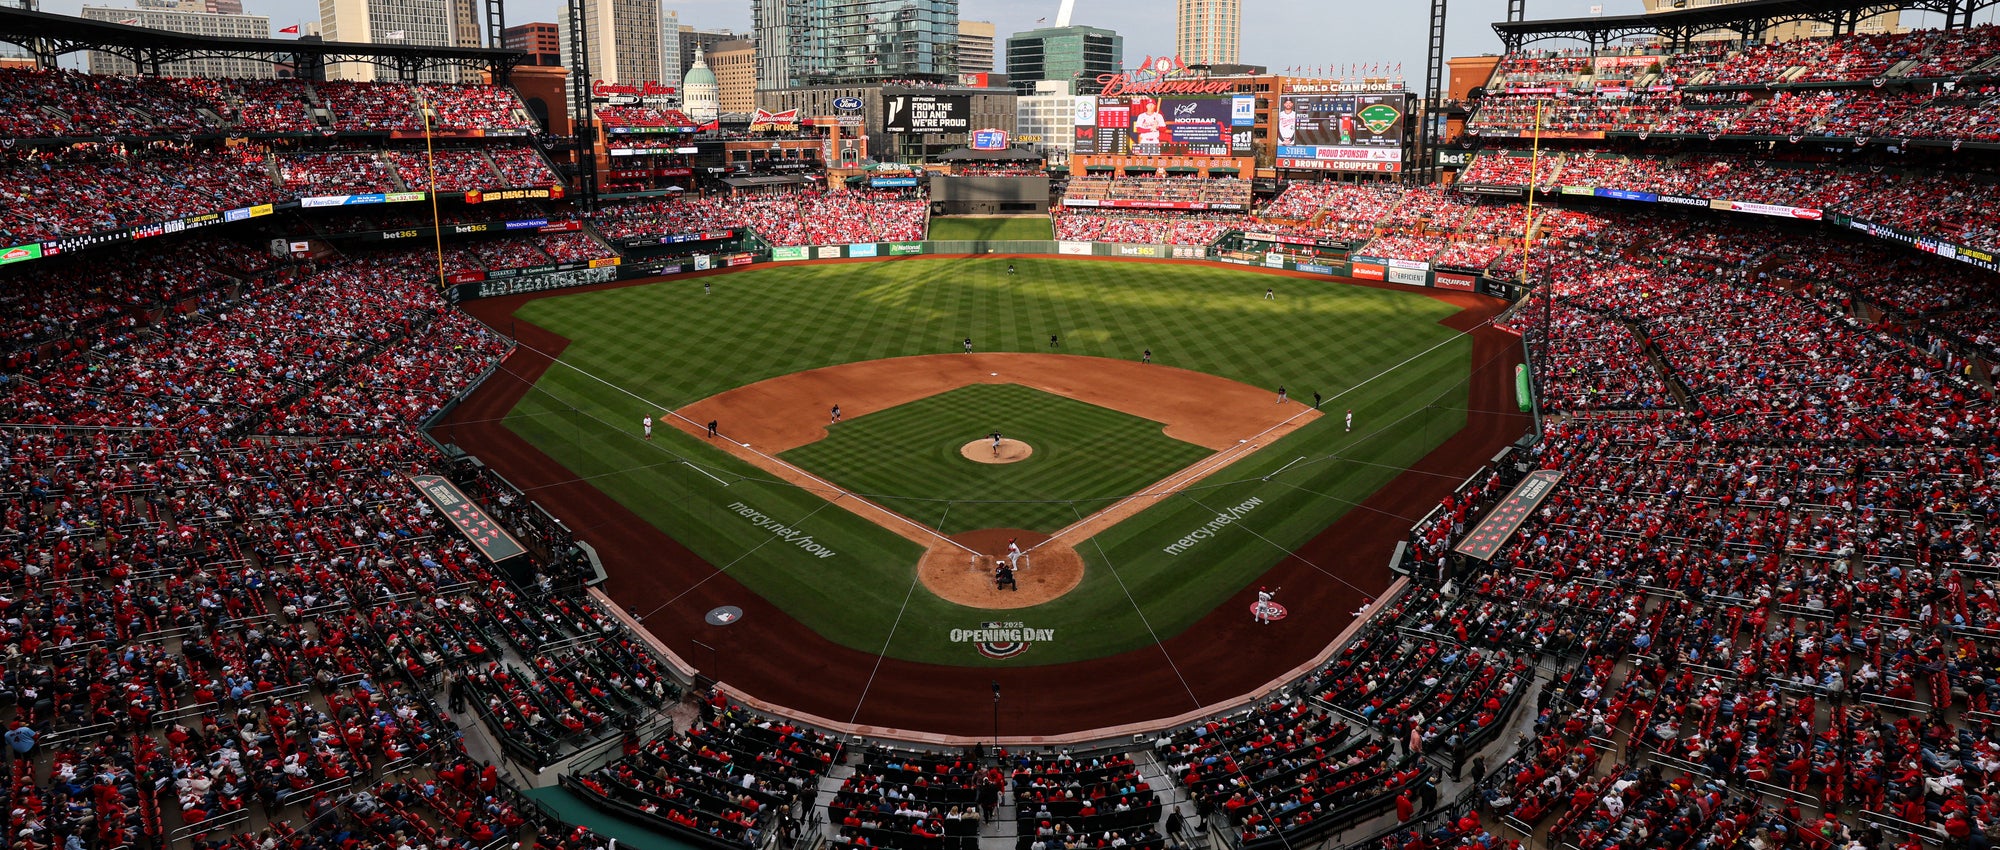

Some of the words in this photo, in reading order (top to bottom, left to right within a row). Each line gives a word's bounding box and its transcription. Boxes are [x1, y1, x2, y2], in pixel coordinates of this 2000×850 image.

[638, 80, 676, 97] Nation
[1096, 73, 1232, 96] Budweiser
[1292, 84, 1328, 92] WORLD
[1330, 84, 1392, 92] CHAMPIONS
[839, 98, 858, 108] Ford
[912, 103, 936, 111] FROM
[937, 103, 953, 111] THE
[750, 112, 798, 123] Budweiser
[912, 111, 928, 119] LOU
[929, 111, 947, 119] AND
[912, 119, 938, 127] WE'RE
[939, 119, 967, 127] PROUD
[1232, 131, 1252, 143] stl
[1286, 147, 1307, 155] STIFEL
[1318, 149, 1338, 158] PROUD
[1339, 150, 1369, 159] SPONSOR
[1294, 160, 1324, 168] BROWN
[1333, 161, 1378, 170] CROUPPEN
[502, 190, 524, 200] MAC
[525, 189, 549, 198] LAND
[1658, 196, 1708, 207] LINDENWOOD.EDU
[456, 225, 487, 233] bet365
[383, 230, 417, 239] bet365
[1121, 246, 1154, 255] bet365
[1437, 276, 1472, 287] EQUIFAX
[728, 502, 836, 558] mercy.net/now
[1163, 497, 1263, 556] mercy.net/now
[950, 628, 1021, 642] OPENING
[1023, 627, 1055, 641] DAY
